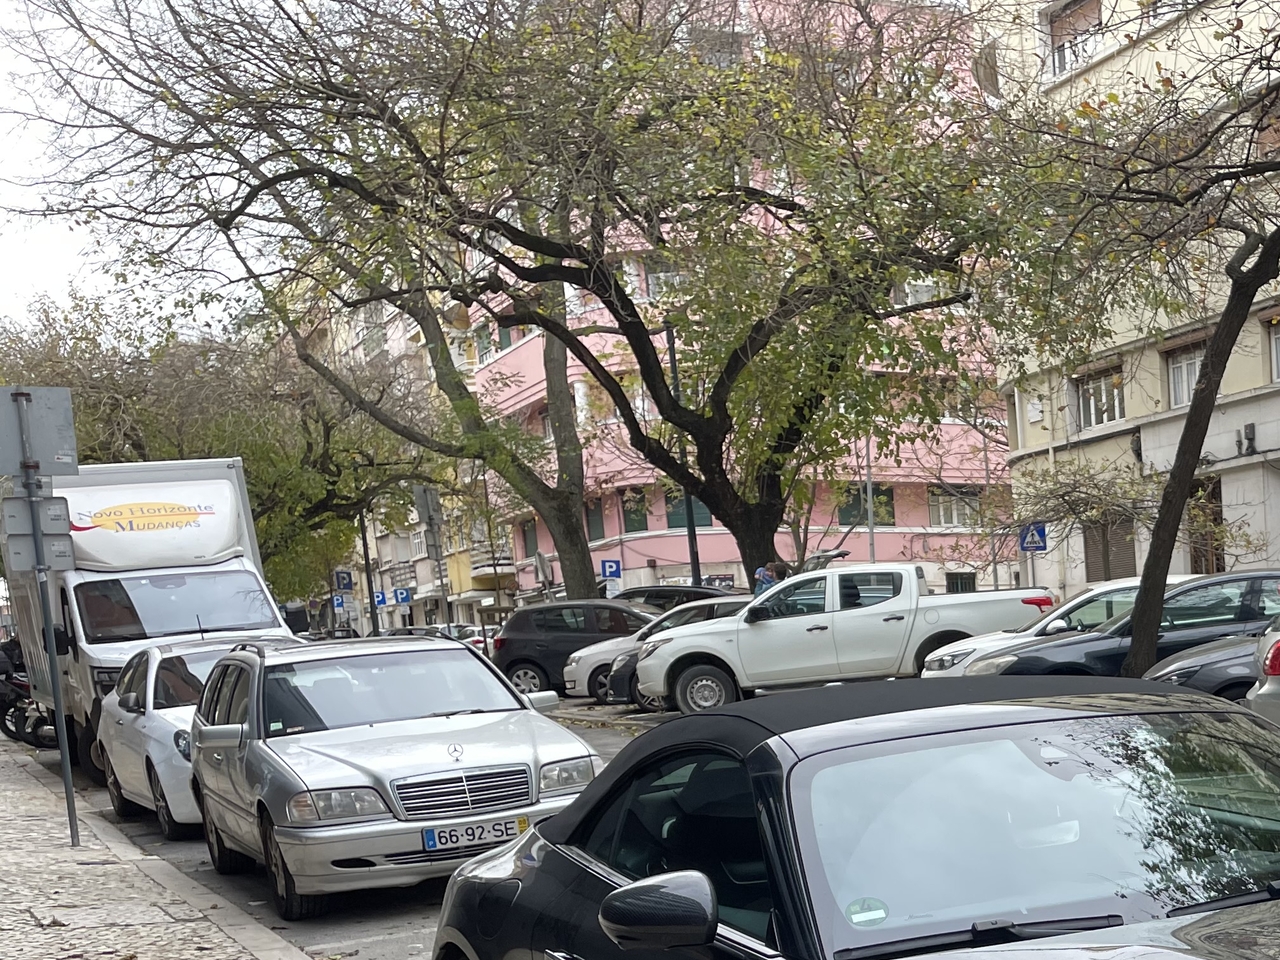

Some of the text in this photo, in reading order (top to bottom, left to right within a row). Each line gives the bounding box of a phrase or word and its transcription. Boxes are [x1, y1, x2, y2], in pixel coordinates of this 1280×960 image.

[77, 509, 123, 521] Novo
[129, 504, 214, 516] Horizonte
[114, 519, 201, 534] MUDANÇAS
[605, 562, 617, 576] P
[333, 596, 342, 607] P
[397, 590, 407, 602] P
